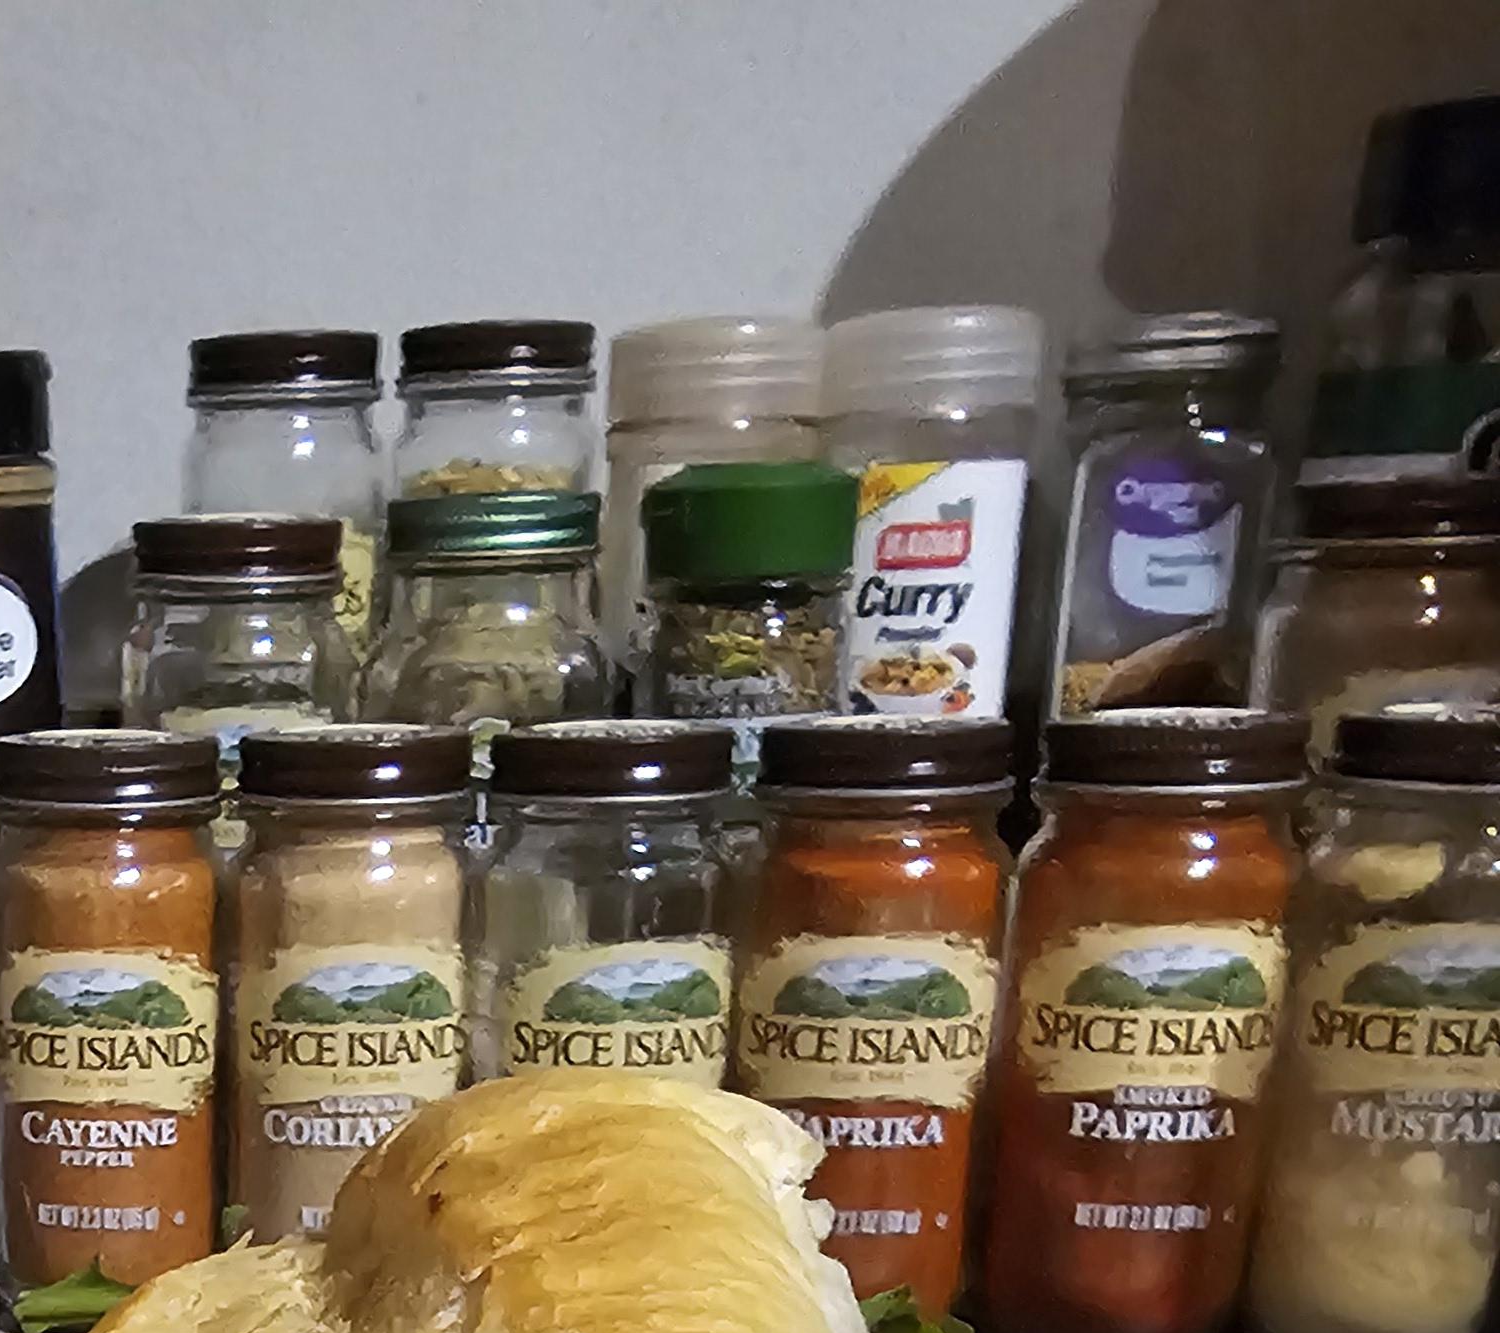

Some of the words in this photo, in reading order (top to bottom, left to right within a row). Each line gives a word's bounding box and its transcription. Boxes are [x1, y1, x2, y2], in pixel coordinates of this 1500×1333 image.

[857, 576, 975, 624] Curry
[77, 1024, 209, 1071] ISLANDS
[250, 1020, 338, 1067] SPICE
[347, 1023, 468, 1067] ISLAND
[512, 1021, 614, 1067] SPICE
[748, 1013, 840, 1063] SPICE
[1033, 1002, 1139, 1055] SPICE
[1144, 1010, 1274, 1056] ISLAND
[1308, 1001, 1419, 1055] SPICE
[1426, 1017, 1500, 1056] ISLA
[21, 1111, 180, 1149] CAYENNE
[264, 1109, 393, 1147] CORIA
[1069, 1101, 1236, 1142] PAPRIKA
[1331, 1099, 1500, 1144] MUSTAR
